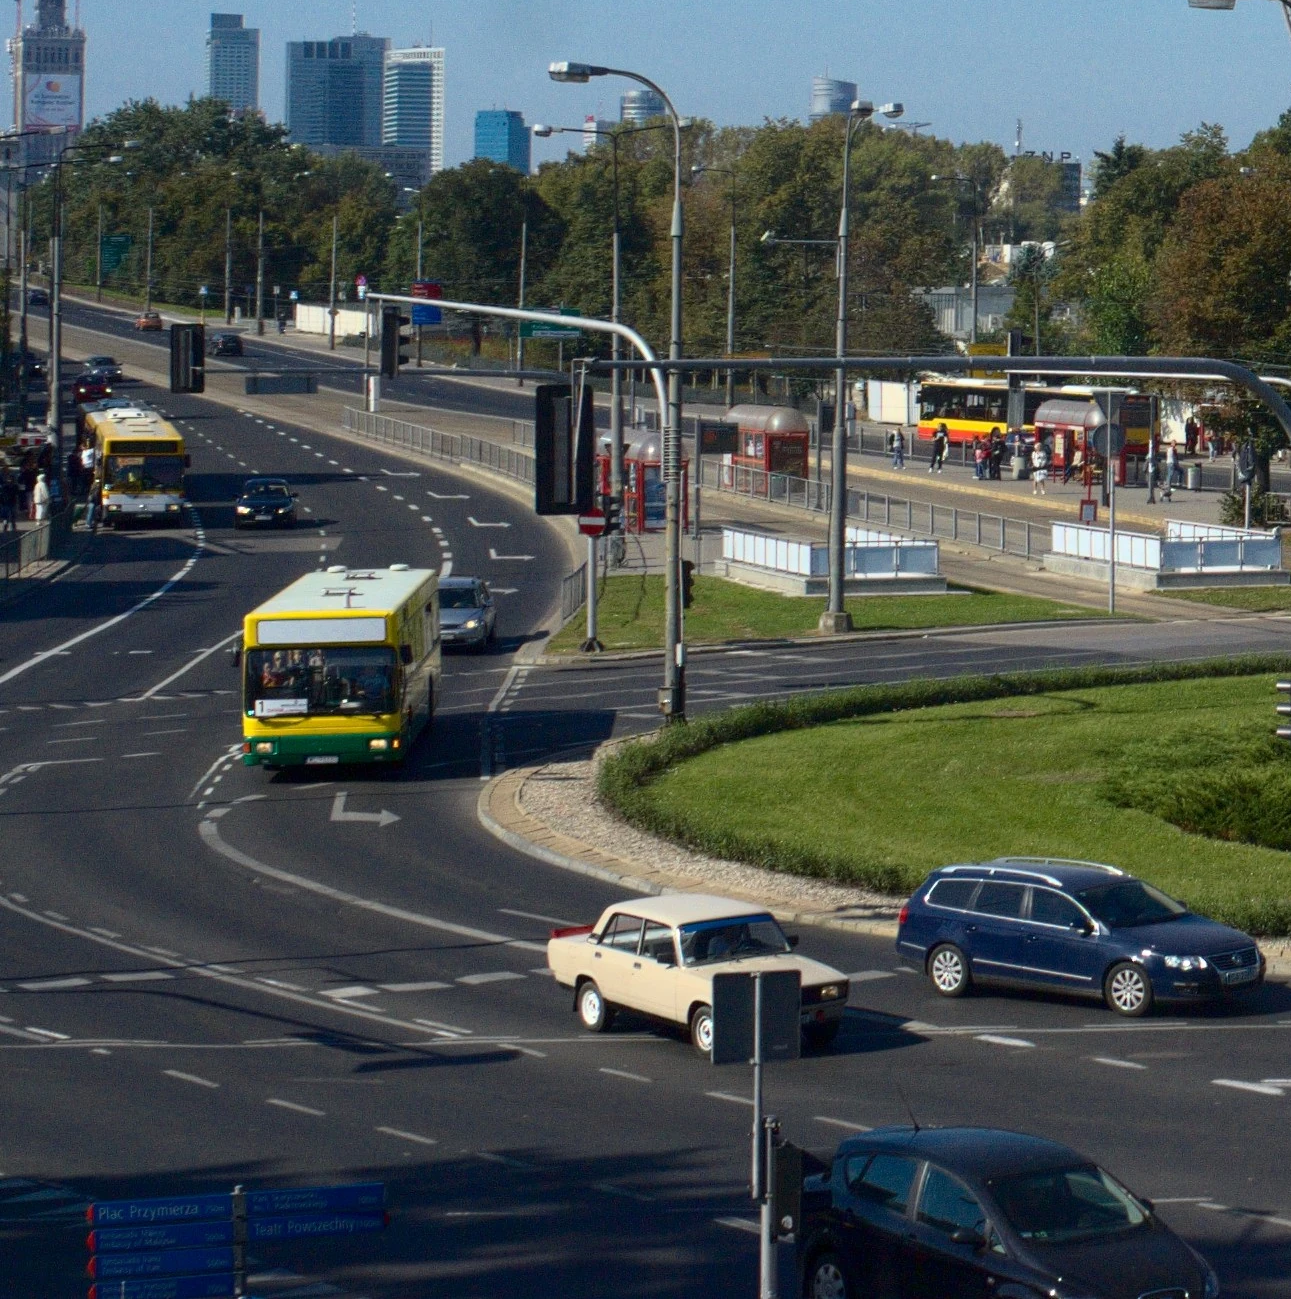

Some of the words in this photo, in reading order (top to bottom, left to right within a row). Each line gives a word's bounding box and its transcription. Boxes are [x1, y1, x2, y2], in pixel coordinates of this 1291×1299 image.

[258, 700, 264, 712] 1
[98, 1207, 124, 1220] Plac
[130, 1203, 199, 1221] Przymierza
[253, 1222, 282, 1236] Teatr
[287, 1216, 355, 1233] Powszechny
